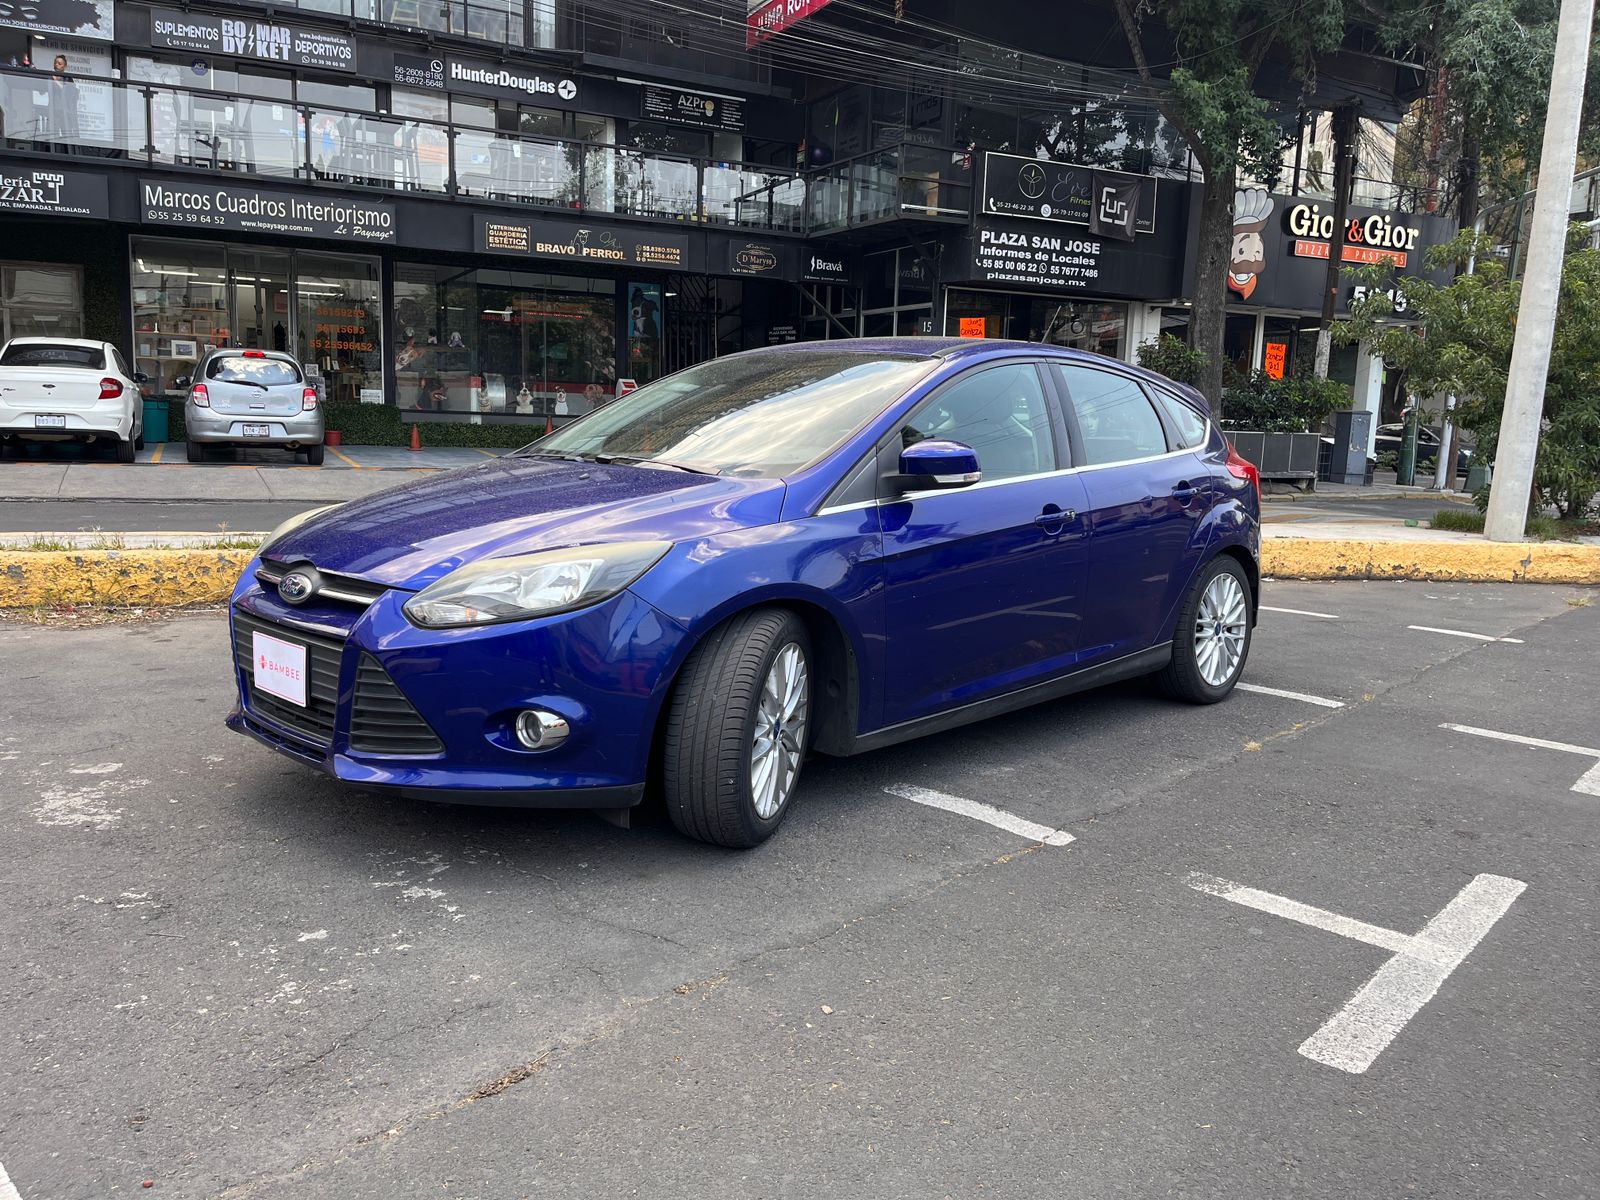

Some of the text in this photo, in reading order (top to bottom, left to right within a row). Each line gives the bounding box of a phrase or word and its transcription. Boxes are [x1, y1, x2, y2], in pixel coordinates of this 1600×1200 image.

[155, 20, 219, 41] SUPLEMENTOS
[294, 39, 352, 60] DEPORTIVOS
[451, 62, 556, 94] HunterDouglas
[12, 202, 54, 211] EMPANADAS,
[54, 205, 91, 214] ENSALADAS
[145, 185, 391, 228] Marcos Cuadros Interiorismo
[158, 211, 226, 225] 55 25 59 64 52
[240, 220, 314, 233] www.lepaysage.com.mx
[334, 224, 348, 235] Le
[536, 242, 576, 255] BRAVO
[981, 230, 1101, 255] PLAZA SAN JOSE
[979, 245, 1096, 266] Informes de Locales
[816, 258, 843, 272] Bravá
[982, 258, 1099, 278] 55 85 00 06 22 55 7677 7486
[986, 271, 1087, 287] plazasanjose.mx
[922, 320, 933, 333] 15
[268, 660, 301, 681] BAMBEE
